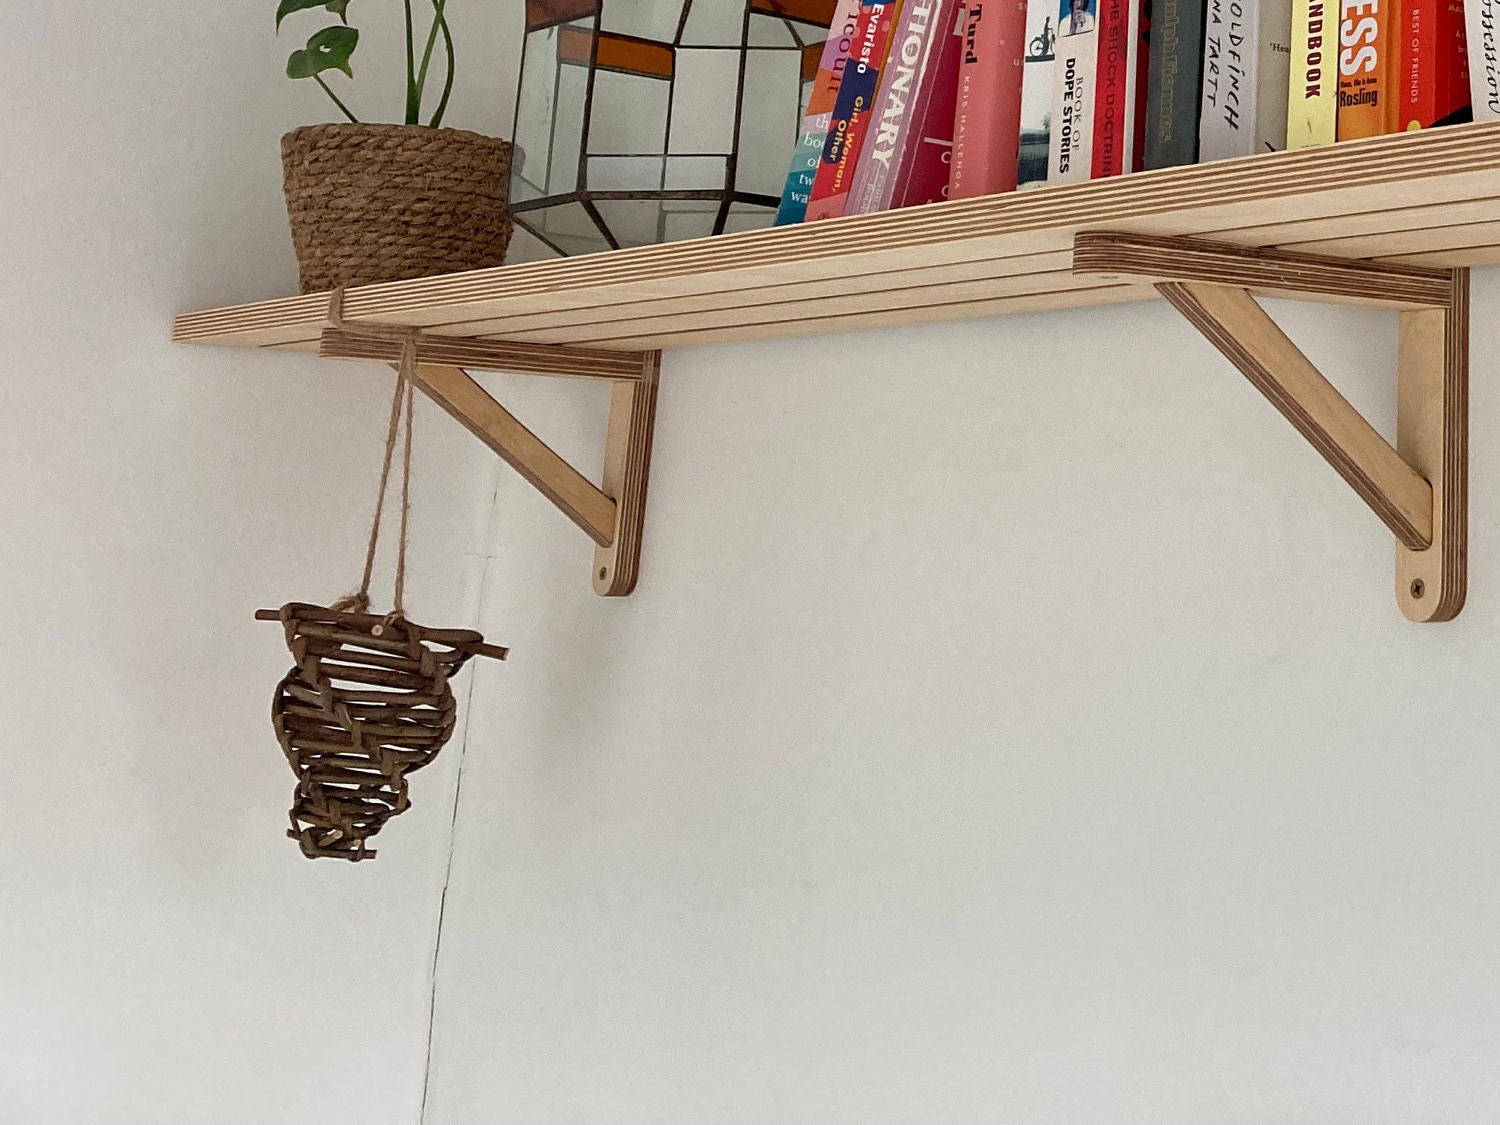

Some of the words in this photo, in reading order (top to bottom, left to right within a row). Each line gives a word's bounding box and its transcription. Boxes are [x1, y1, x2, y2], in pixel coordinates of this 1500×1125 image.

[857, 3, 884, 74] Evaristo
[965, 3, 983, 64] Turd
[1412, 9, 1420, 34] BEST
[1106, 26, 1118, 88] SHOCK
[1411, 38, 1419, 53] OF
[961, 76, 971, 108] KRIS
[1063, 57, 1076, 101] DOPE
[1207, 36, 1220, 108] TARTT
[1410, 58, 1419, 104] FRIENDS
[1074, 77, 1084, 123] BOOK
[1339, 87, 1378, 108] Rosling
[815, 114, 828, 130] th
[830, 119, 847, 162] Other
[1059, 106, 1073, 174] STORIES
[1072, 131, 1081, 151] OF
[1102, 94, 1114, 176] DOCTRIN
[832, 133, 855, 193] Woman,
[954, 115, 967, 189] HALLENGA
[799, 173, 815, 186] tw
